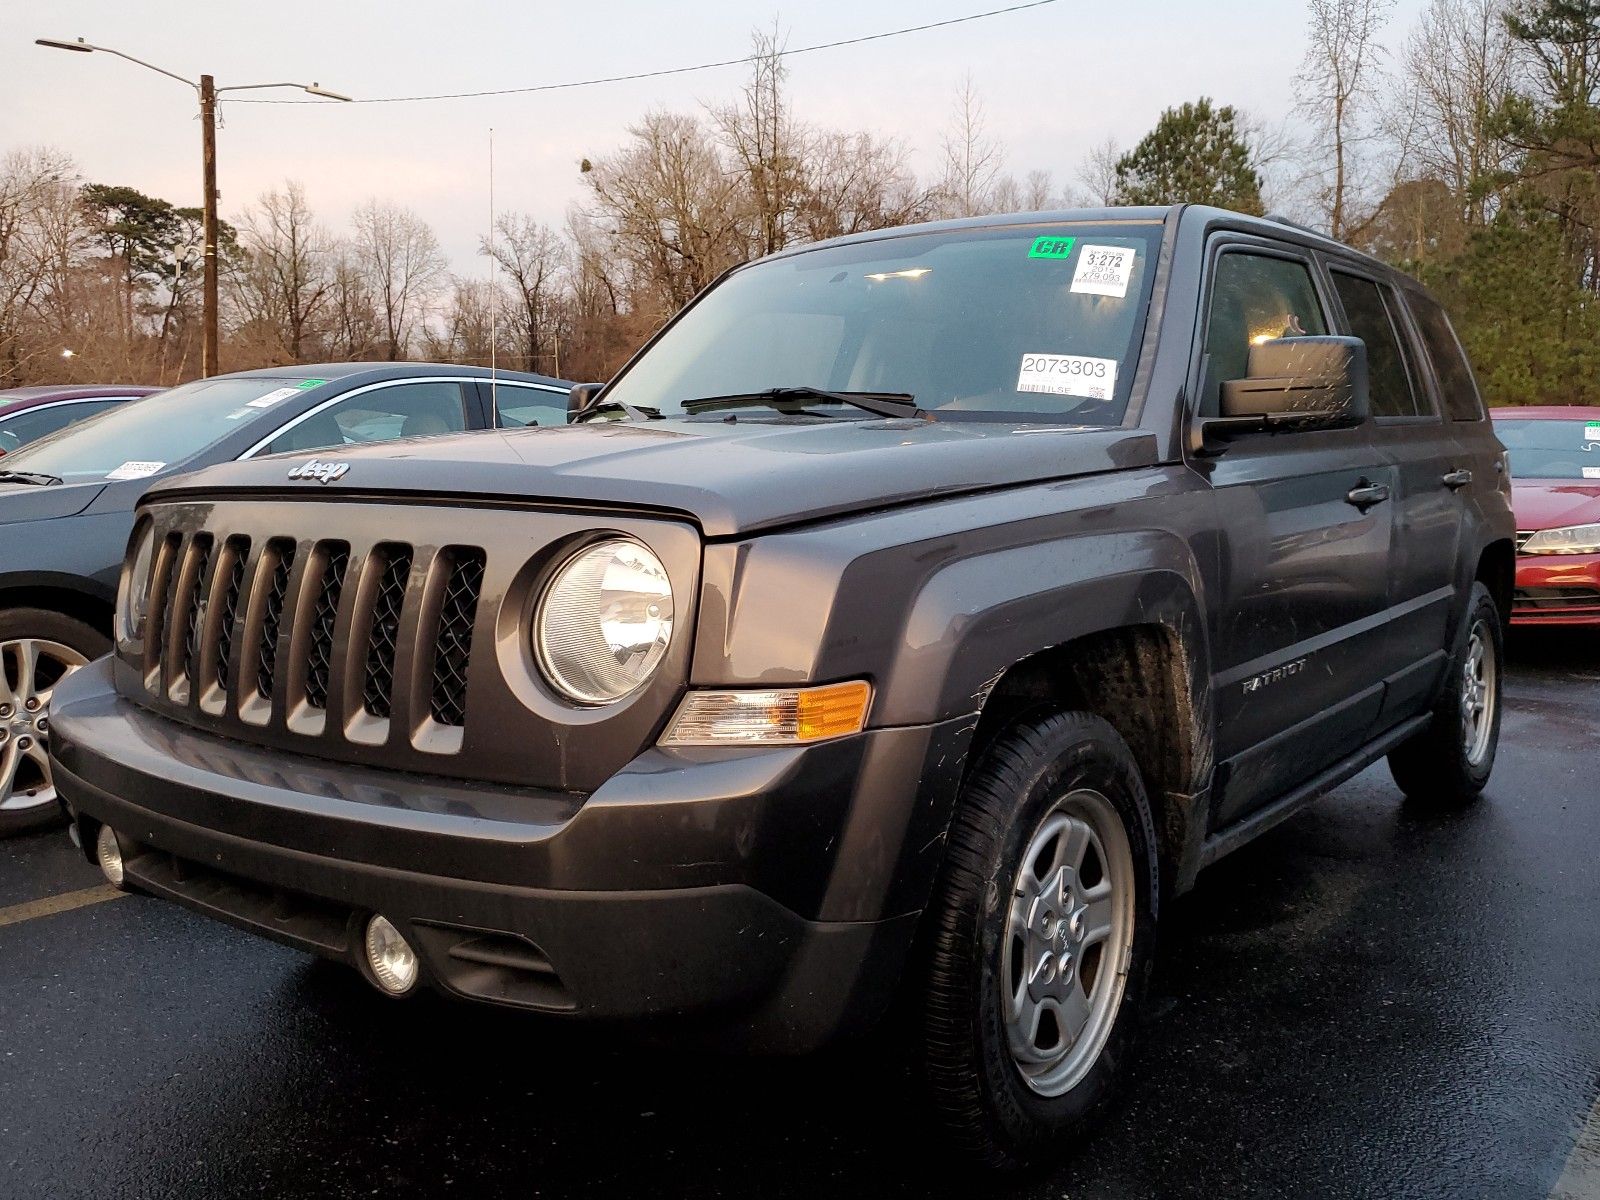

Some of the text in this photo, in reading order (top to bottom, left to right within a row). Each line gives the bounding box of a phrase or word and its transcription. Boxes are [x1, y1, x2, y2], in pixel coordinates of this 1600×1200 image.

[1087, 254, 1123, 268] 3:272
[1092, 265, 1115, 274] 2015
[1023, 357, 1106, 378] 2073303
[287, 459, 350, 485] Jeep
[1242, 658, 1307, 695] PATRIOT
